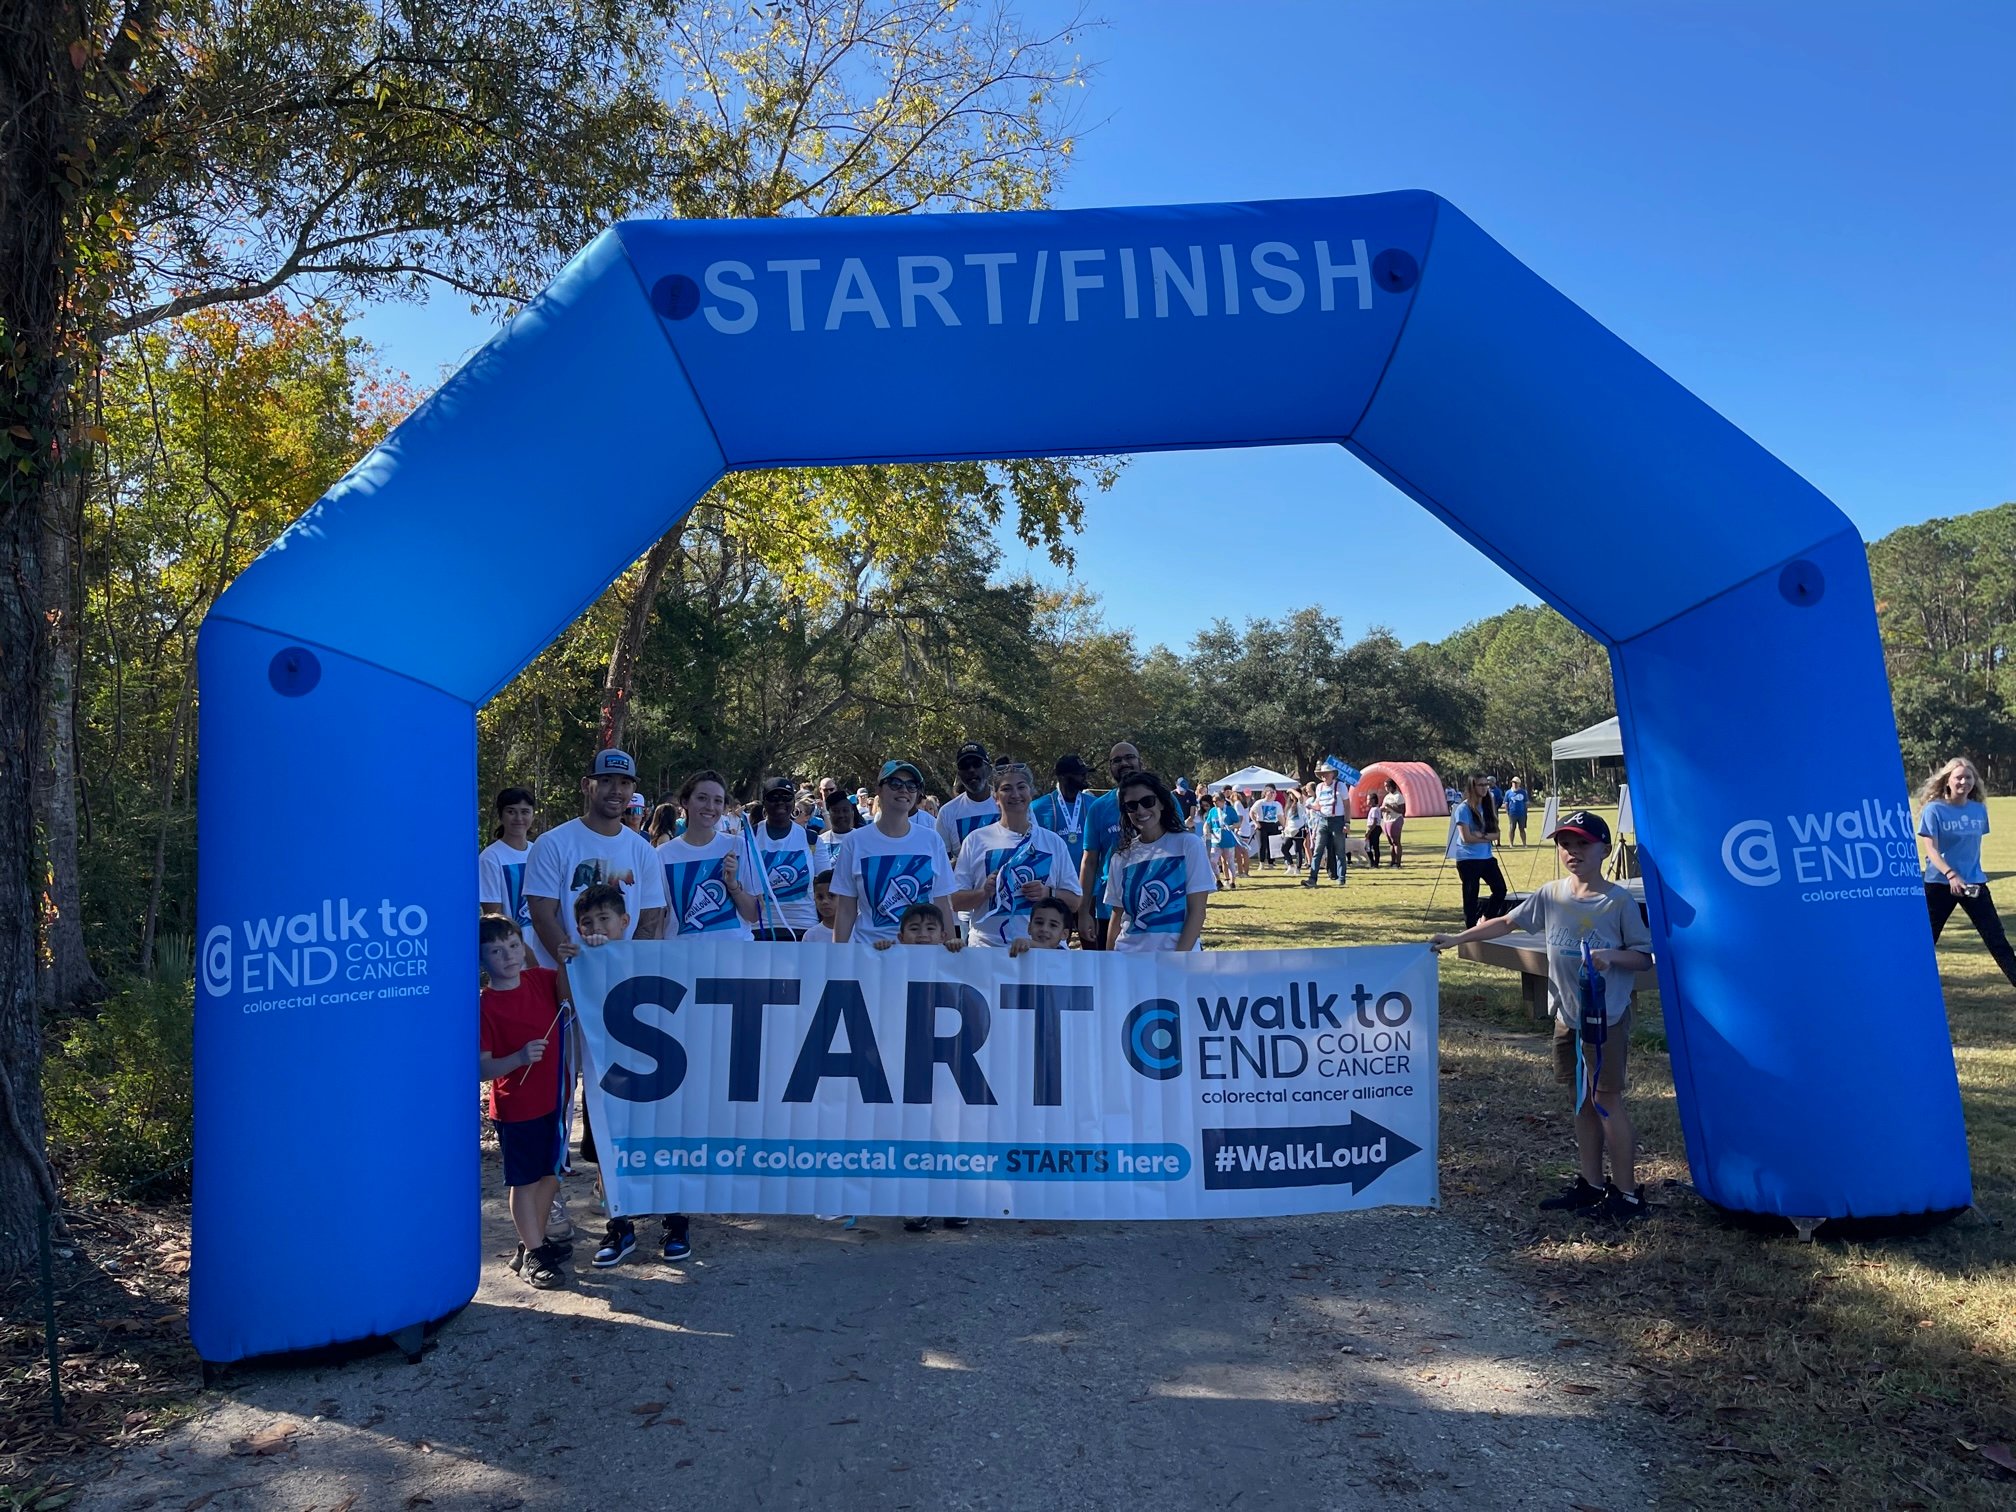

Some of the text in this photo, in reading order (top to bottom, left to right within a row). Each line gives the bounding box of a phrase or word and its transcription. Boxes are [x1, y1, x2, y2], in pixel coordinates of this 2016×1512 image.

[703, 239, 1373, 335] START/FINISH
[1787, 799, 1897, 843] walk
[1793, 842, 1918, 883] END COLO
[1802, 886, 1873, 902] colorectal
[1876, 886, 1909, 897] cancer
[244, 898, 427, 950] walk to
[244, 938, 427, 993] END COLON
[346, 960, 427, 981] CANCER
[244, 986, 429, 1013] colorectal cancer alliance
[1197, 982, 1412, 1031] walk to
[600, 976, 1093, 1106] START
[1199, 1031, 1410, 1079] END COLON
[1318, 1056, 1410, 1077] CANCER
[1202, 1086, 1413, 1103] colorectal cancer alliance
[613, 1144, 1179, 1173] he end of colorectal cancer STARTS here
[1215, 1137, 1387, 1172] #WalkLoud
